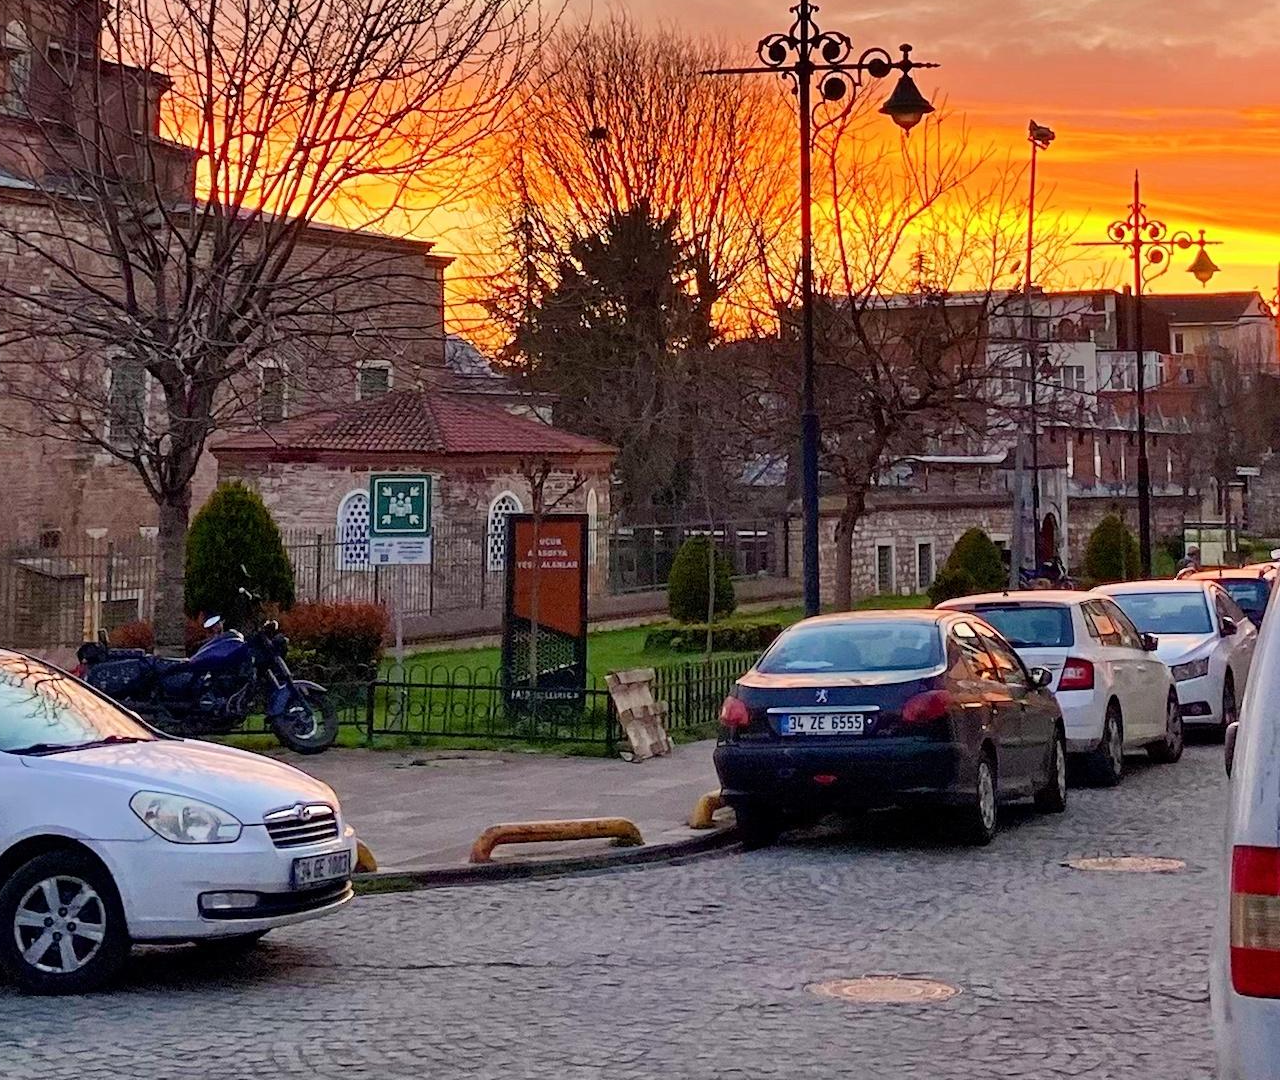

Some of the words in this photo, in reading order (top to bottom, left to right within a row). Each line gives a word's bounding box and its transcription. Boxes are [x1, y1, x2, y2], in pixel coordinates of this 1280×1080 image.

[789, 716, 803, 730] 34
[810, 716, 825, 730] ZE
[832, 716, 862, 730] 6555
